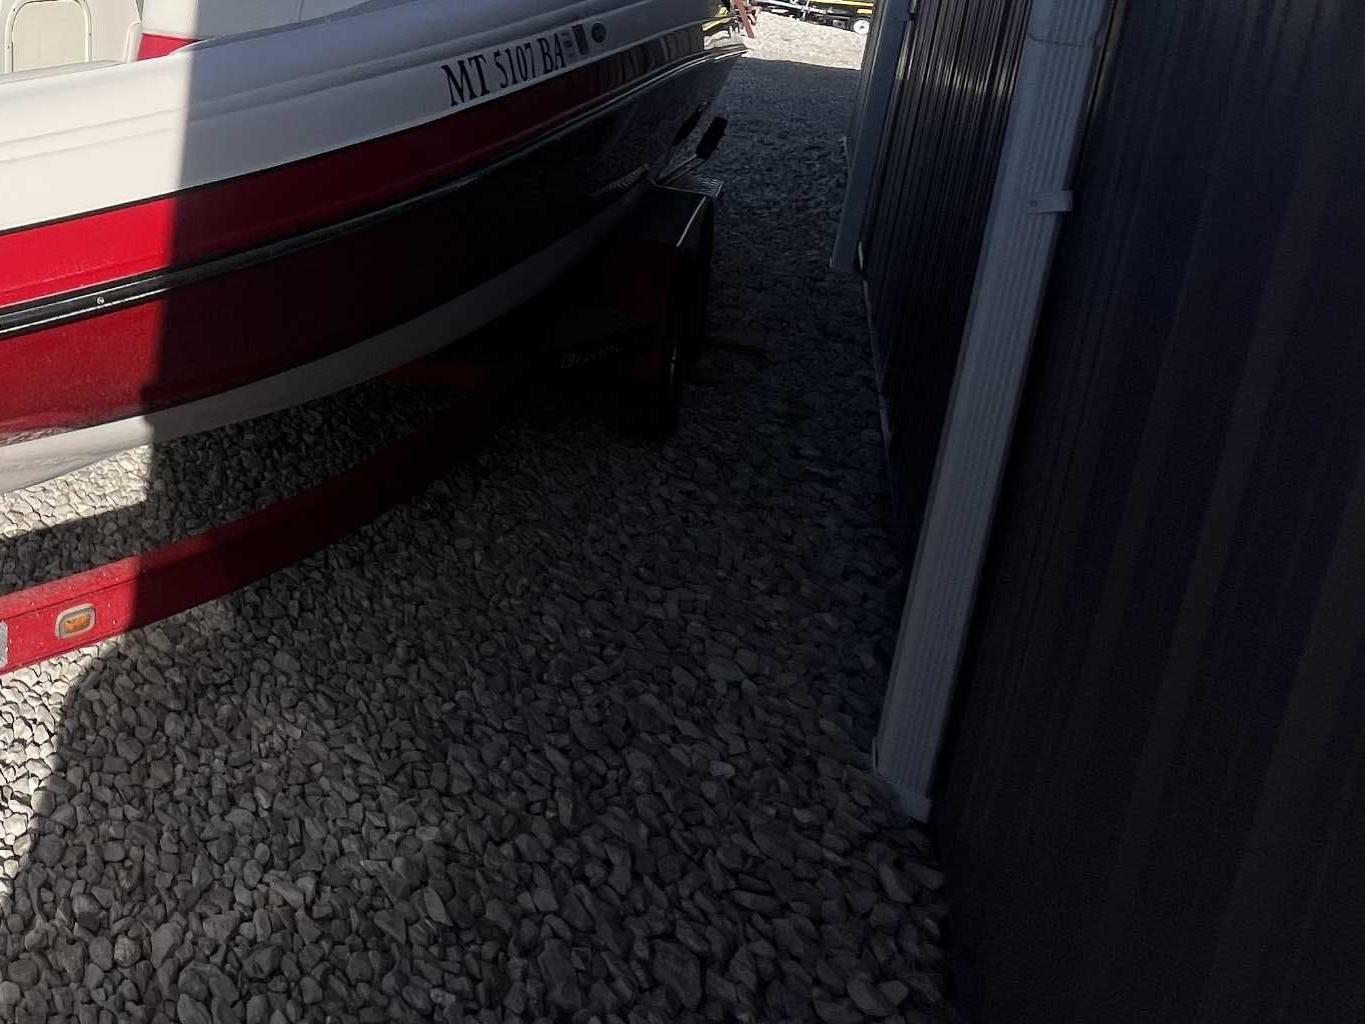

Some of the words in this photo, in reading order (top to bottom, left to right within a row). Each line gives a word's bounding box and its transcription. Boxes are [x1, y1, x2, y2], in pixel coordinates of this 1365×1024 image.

[441, 54, 490, 106] MT
[493, 42, 537, 89] 5107
[537, 33, 567, 74] BA
